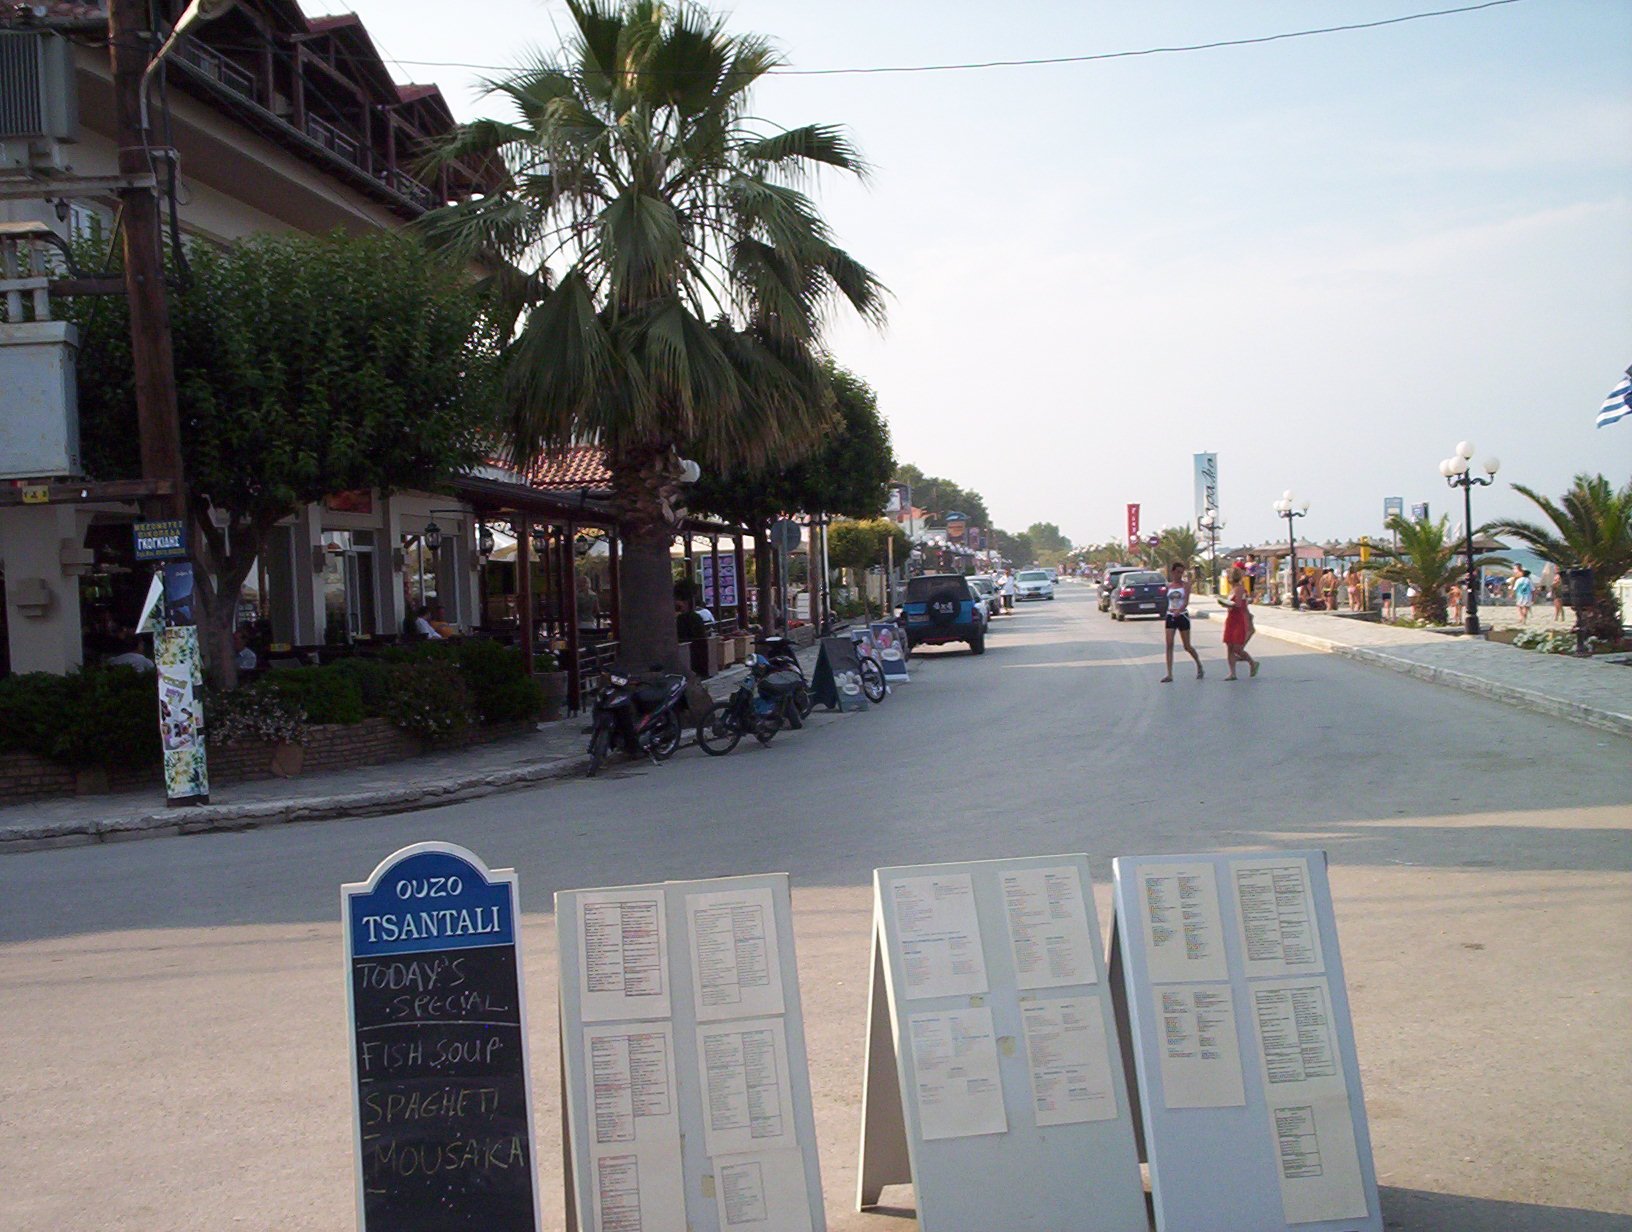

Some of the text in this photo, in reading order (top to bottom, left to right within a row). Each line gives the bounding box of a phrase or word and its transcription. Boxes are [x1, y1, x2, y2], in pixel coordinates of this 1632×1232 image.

[396, 876, 463, 900] OUZO
[362, 906, 501, 942] TSANTALI
[356, 955, 465, 992] TODAY'S
[393, 991, 506, 1018] SPECIAL
[362, 1036, 500, 1070] FISH SOUP
[374, 1136, 525, 1177] MOUSAKA
